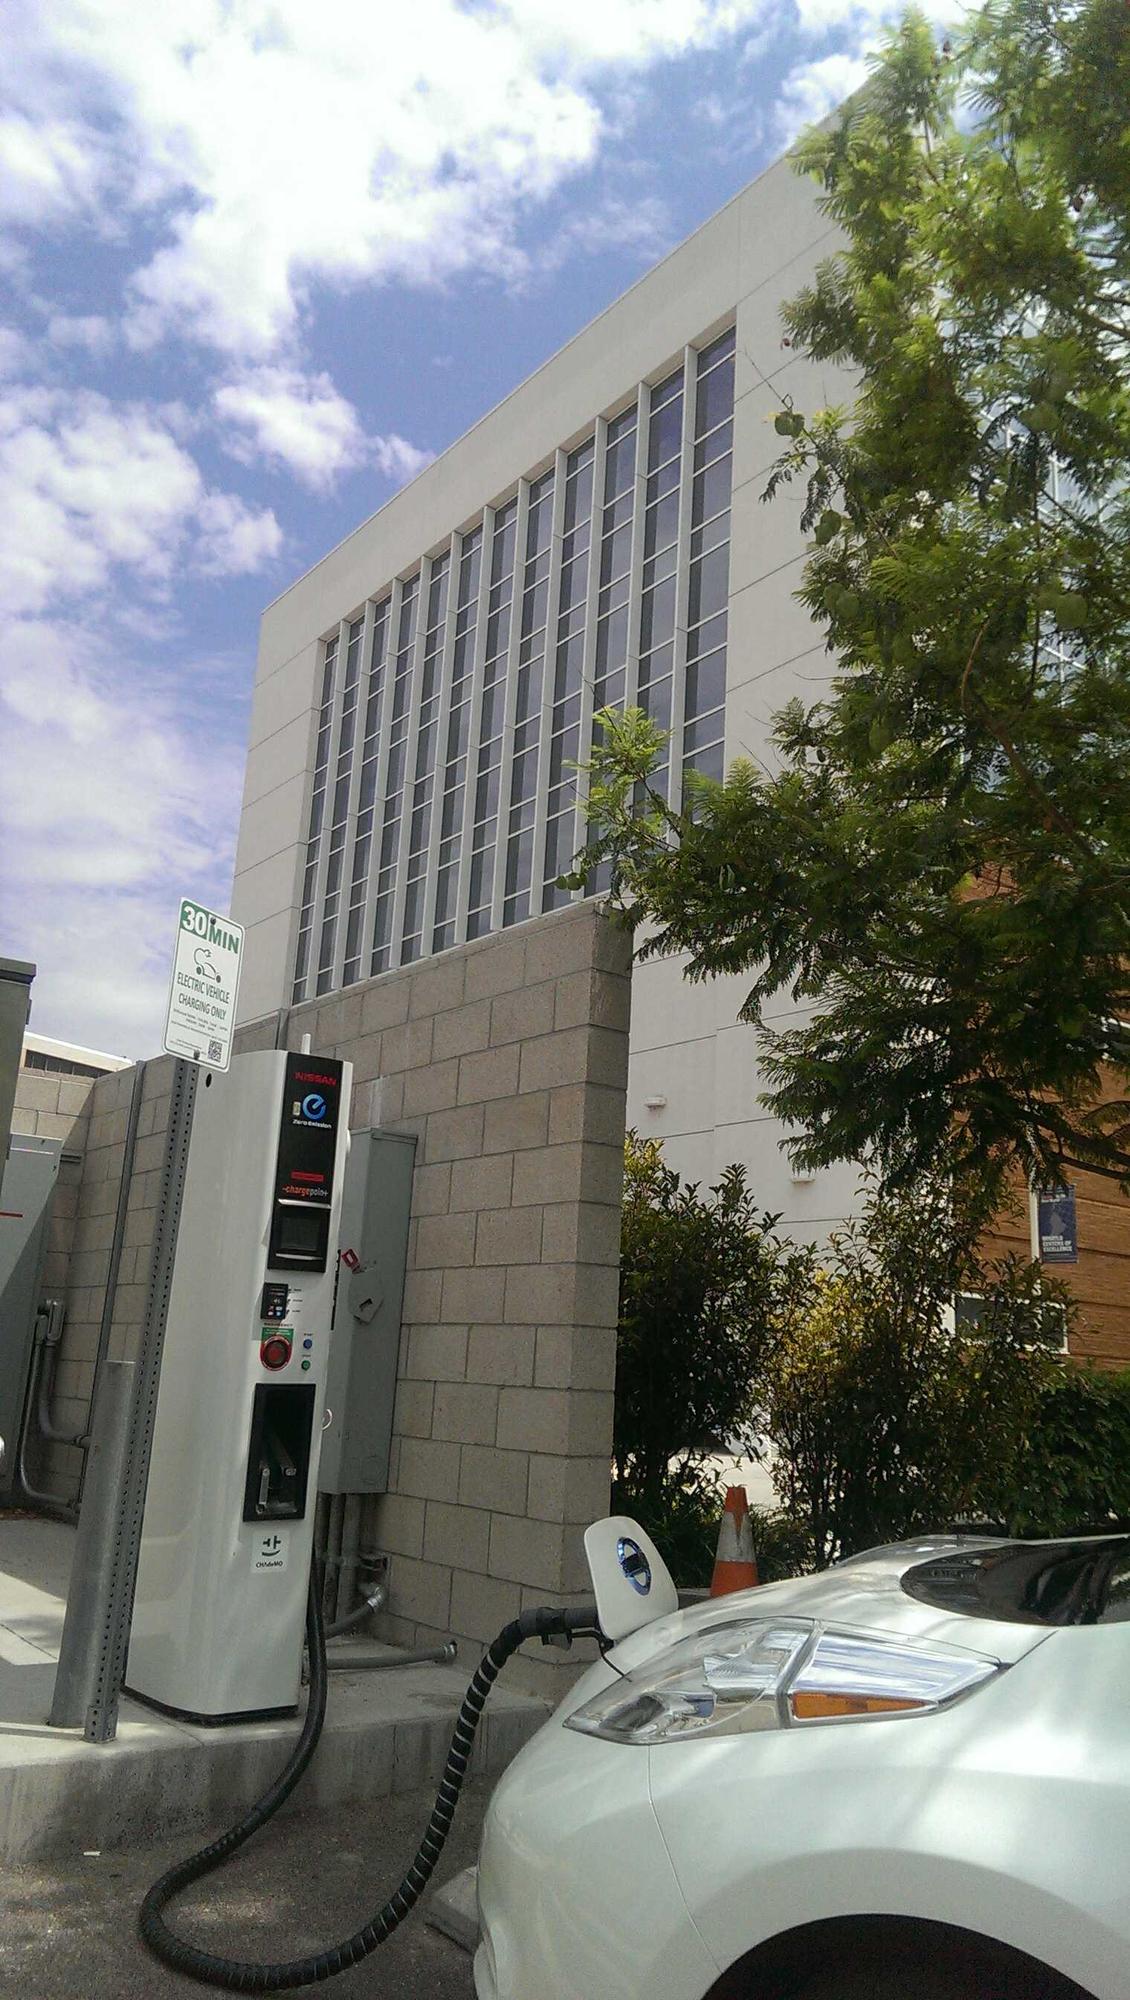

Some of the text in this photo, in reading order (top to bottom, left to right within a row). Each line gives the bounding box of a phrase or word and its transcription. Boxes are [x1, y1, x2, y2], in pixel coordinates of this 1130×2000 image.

[182, 905, 207, 936] 30
[177, 972, 230, 1005] ELECTRIC VEHICLE
[178, 993, 211, 1016] CHARGING
[211, 1005, 227, 1020] ONLY
[294, 1072, 337, 1087] NISSAN
